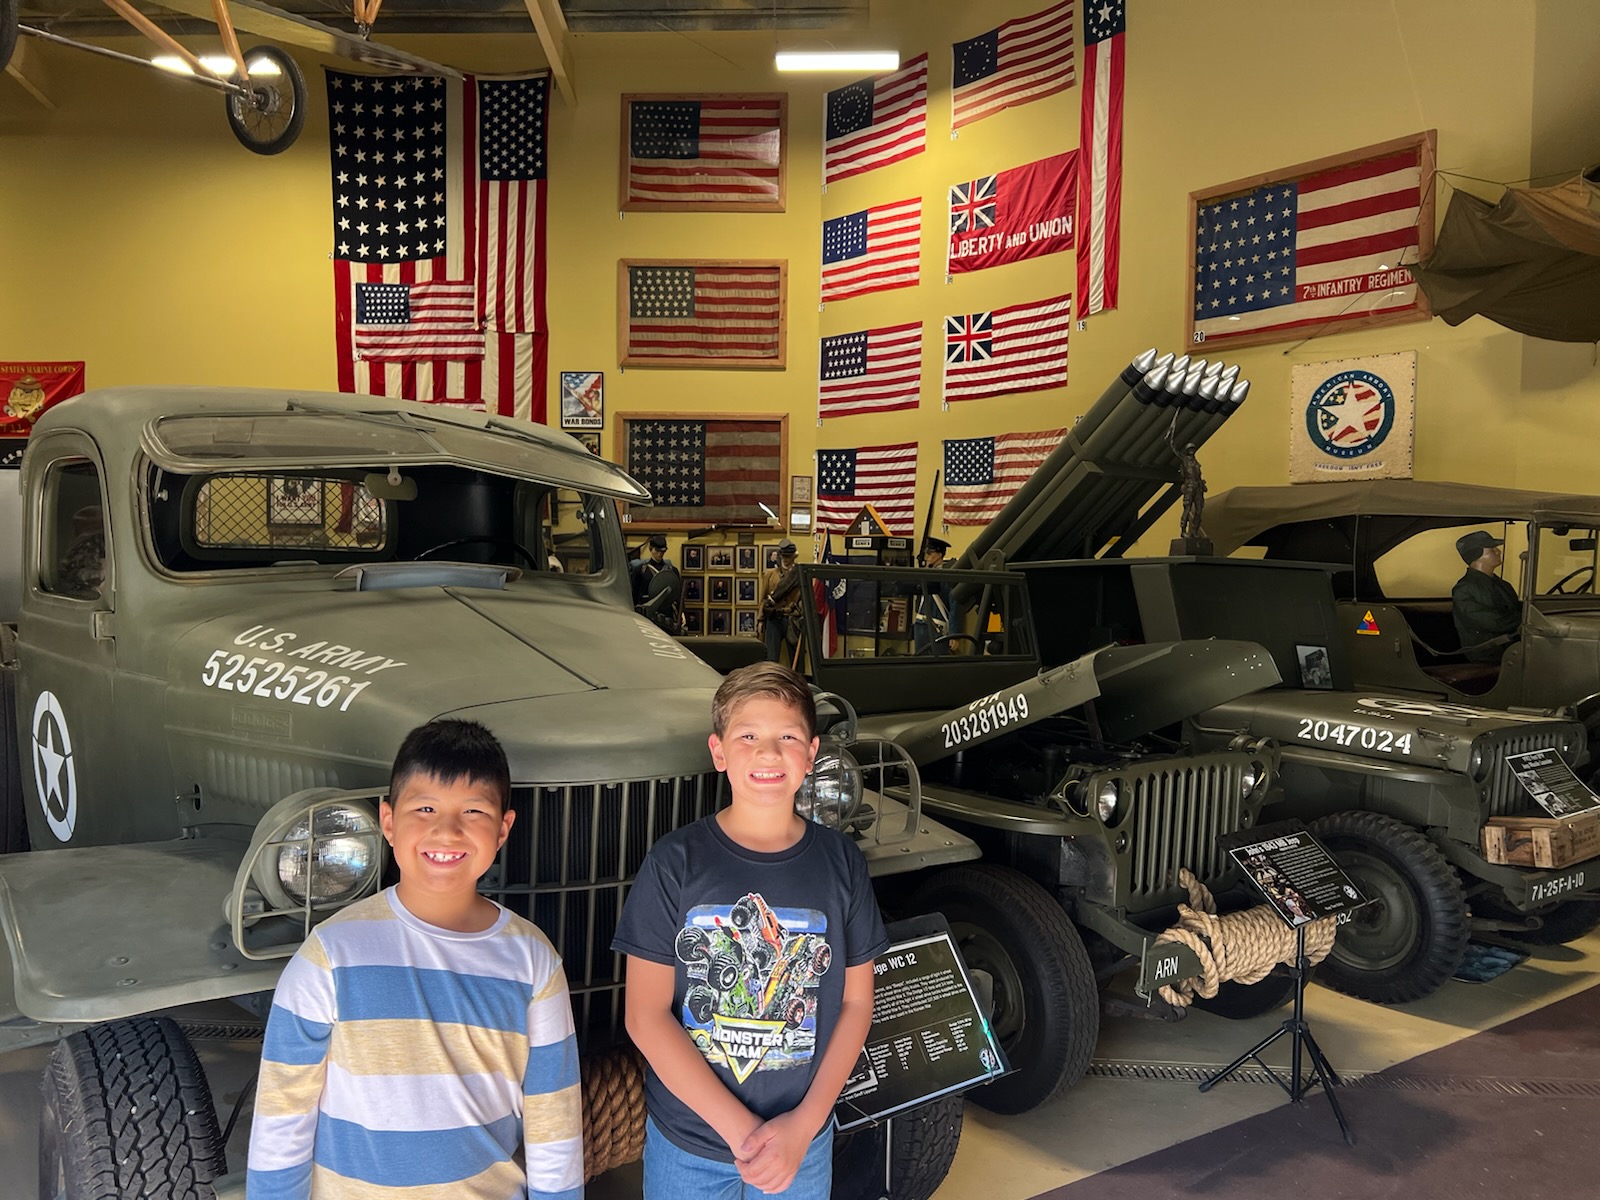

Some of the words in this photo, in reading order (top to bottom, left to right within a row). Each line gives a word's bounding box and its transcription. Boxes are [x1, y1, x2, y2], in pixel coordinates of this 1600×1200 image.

[950, 231, 1004, 260] LIBERTY
[1005, 231, 1027, 249] AND
[1029, 215, 1073, 242] UNION
[1317, 276, 1363, 297] INFANTRY
[1367, 269, 1415, 290] REGIMEN
[1193, 331, 1206, 343] 20
[26, 365, 53, 374] MARINE
[53, 365, 77, 374] CORPS
[1312, 373, 1355, 406] AMERICAN
[1362, 374, 1392, 399] ARMORY
[1325, 443, 1373, 456] MUSEUM
[1366, 461, 1383, 469] FREE
[233, 624, 297, 653] U.S.
[287, 641, 408, 675] ARMY
[202, 649, 372, 712] 52525261
[941, 693, 1029, 749] 203281949
[1297, 718, 1412, 755] 2047024
[887, 954, 906, 970] WC
[905, 952, 918, 966] 12
[1154, 955, 1179, 981] ARN
[712, 1025, 784, 1047] MONSTER
[727, 1043, 761, 1059] JAM
